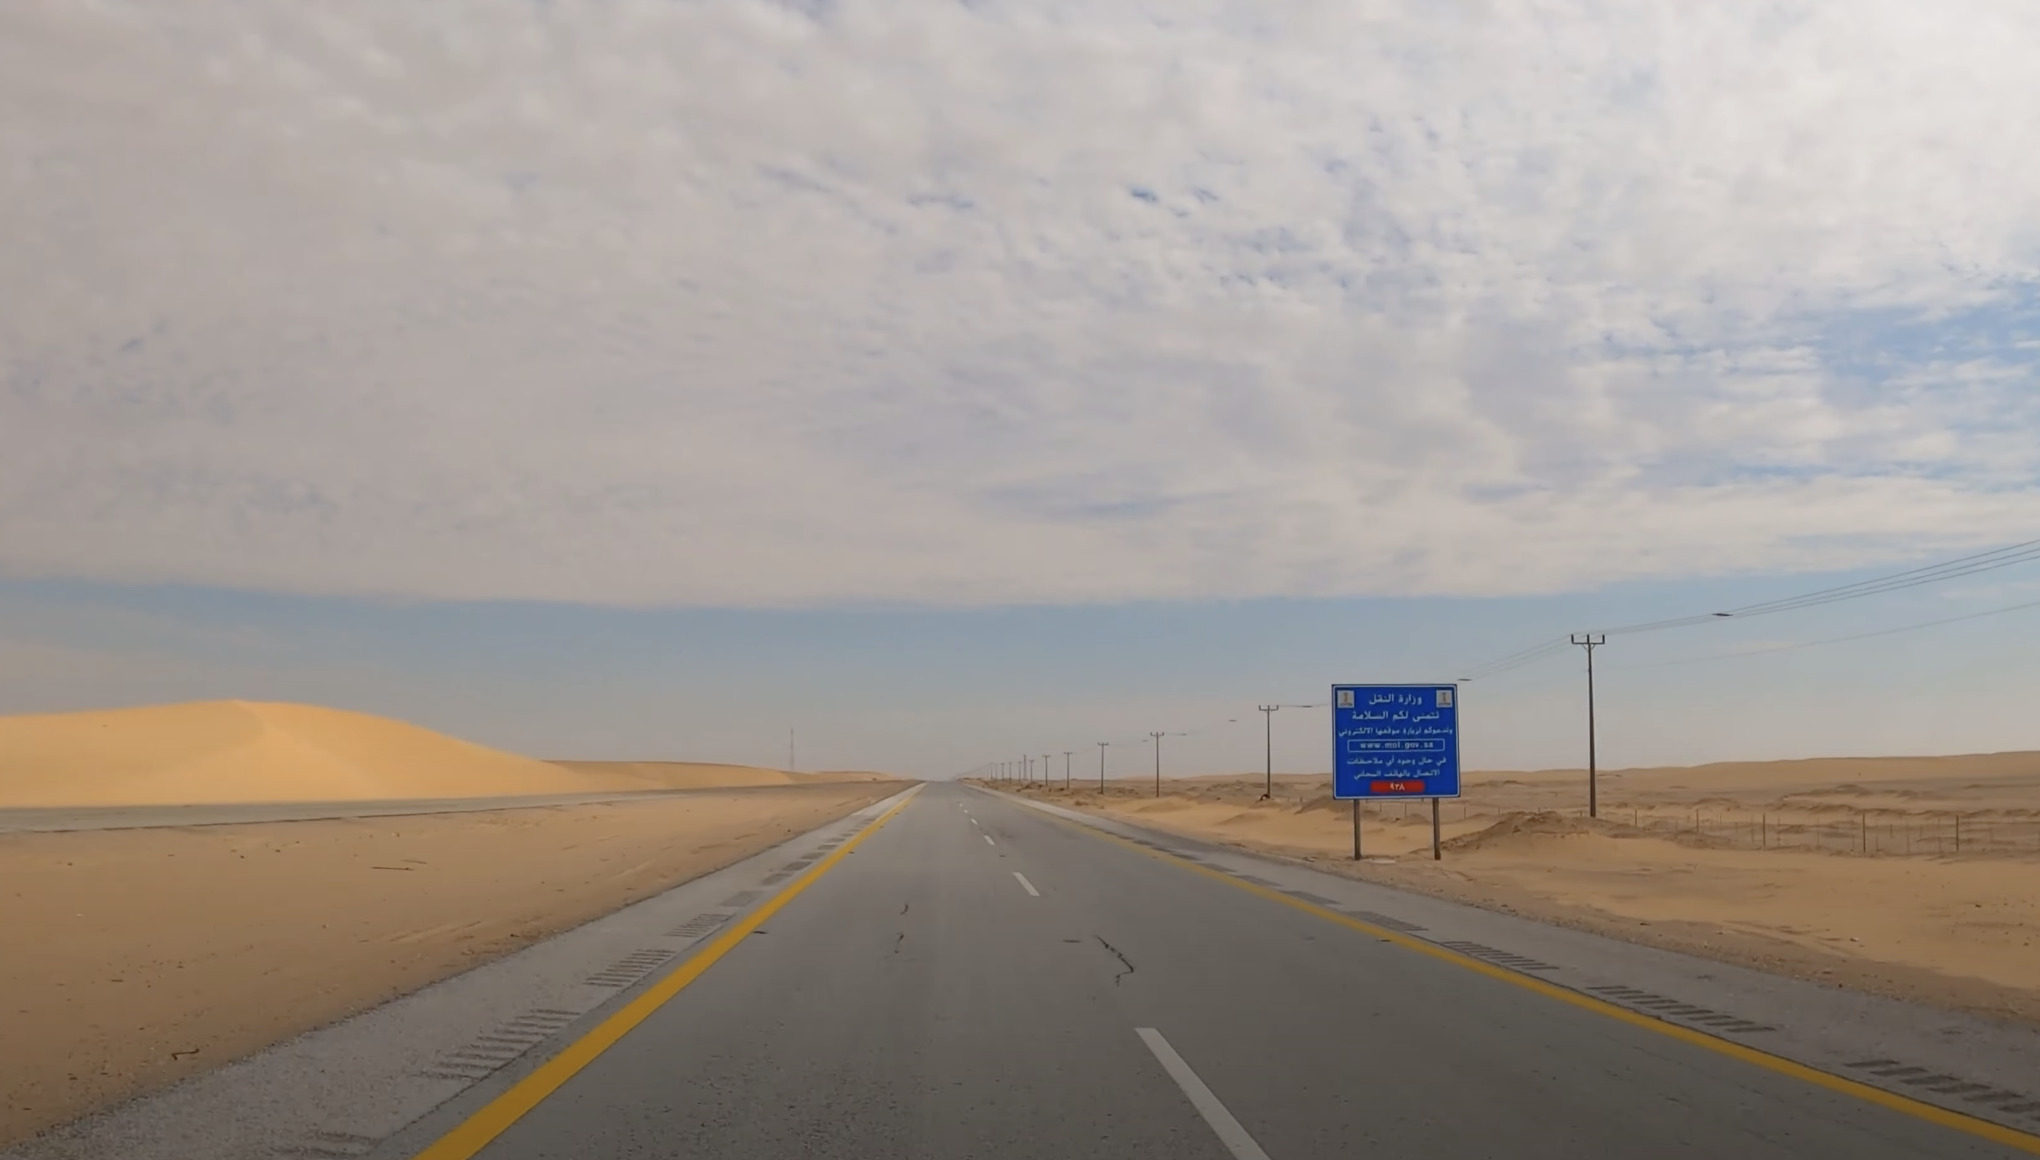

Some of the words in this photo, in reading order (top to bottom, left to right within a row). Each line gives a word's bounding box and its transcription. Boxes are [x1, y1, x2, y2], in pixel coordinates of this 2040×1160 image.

[1369, 693, 1394, 705] النقل
[1398, 694, 1422, 705] وزارة
[1352, 711, 1389, 720] السلامة
[1393, 710, 1409, 722] لكم
[1347, 757, 1383, 765] ملاحظات
[1385, 755, 1395, 766] أي
[1418, 757, 1433, 765] حال
[1436, 757, 1447, 766] في
